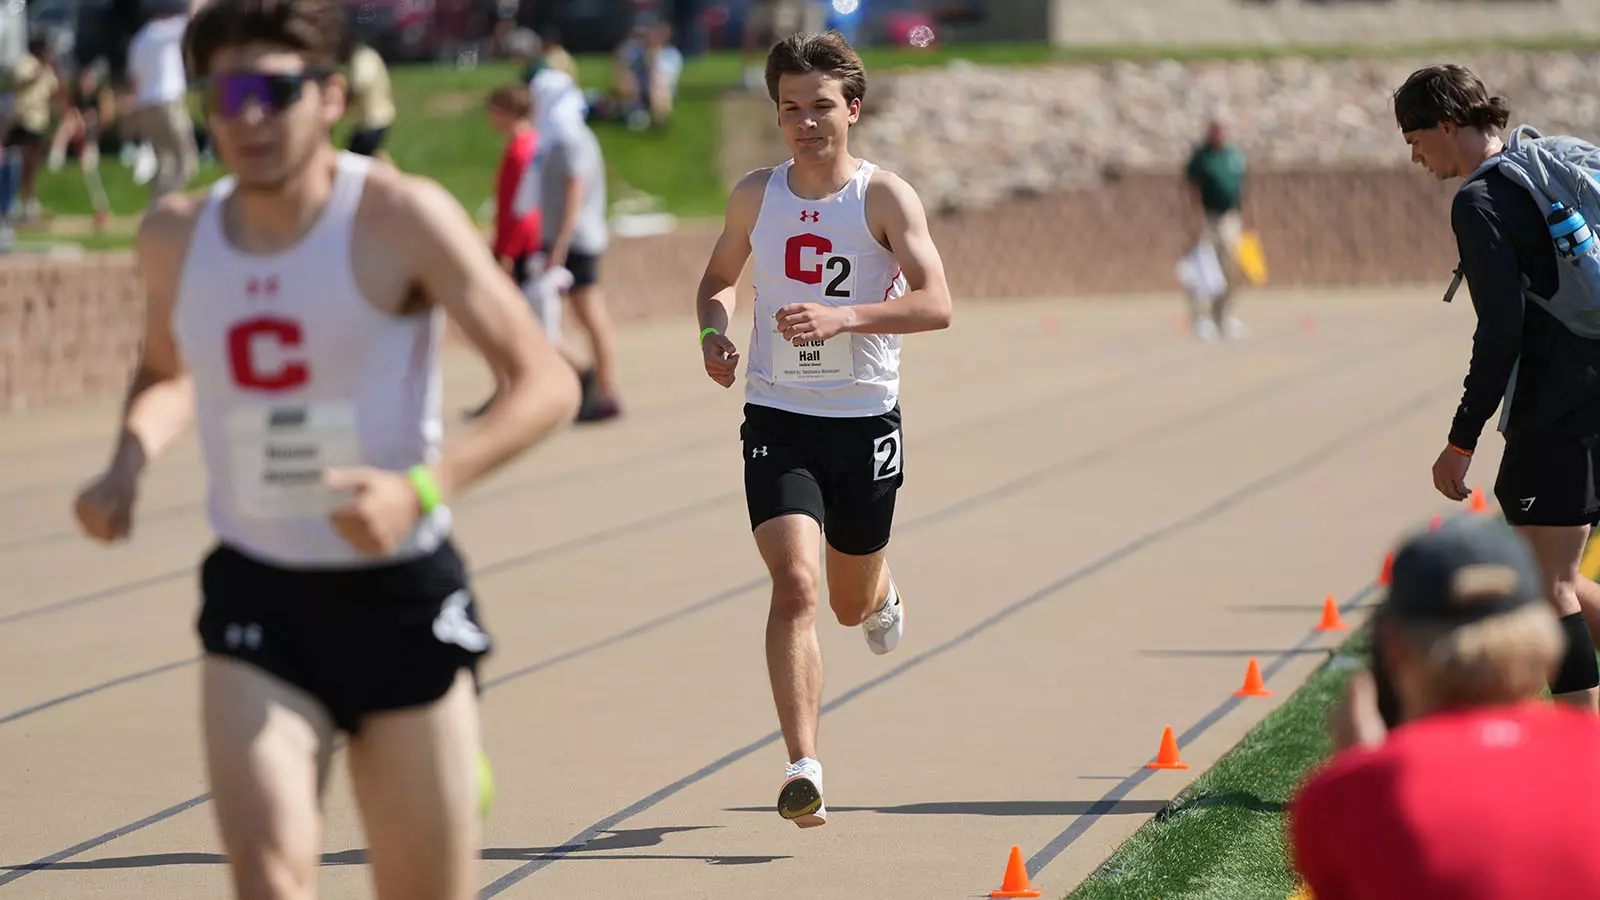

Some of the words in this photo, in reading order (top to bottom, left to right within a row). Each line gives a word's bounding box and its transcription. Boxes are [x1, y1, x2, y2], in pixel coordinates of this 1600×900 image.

[785, 233, 832, 284] C
[825, 256, 851, 297] 2
[228, 317, 309, 391] C
[799, 350, 820, 361] Hall
[877, 437, 897, 477] 2
